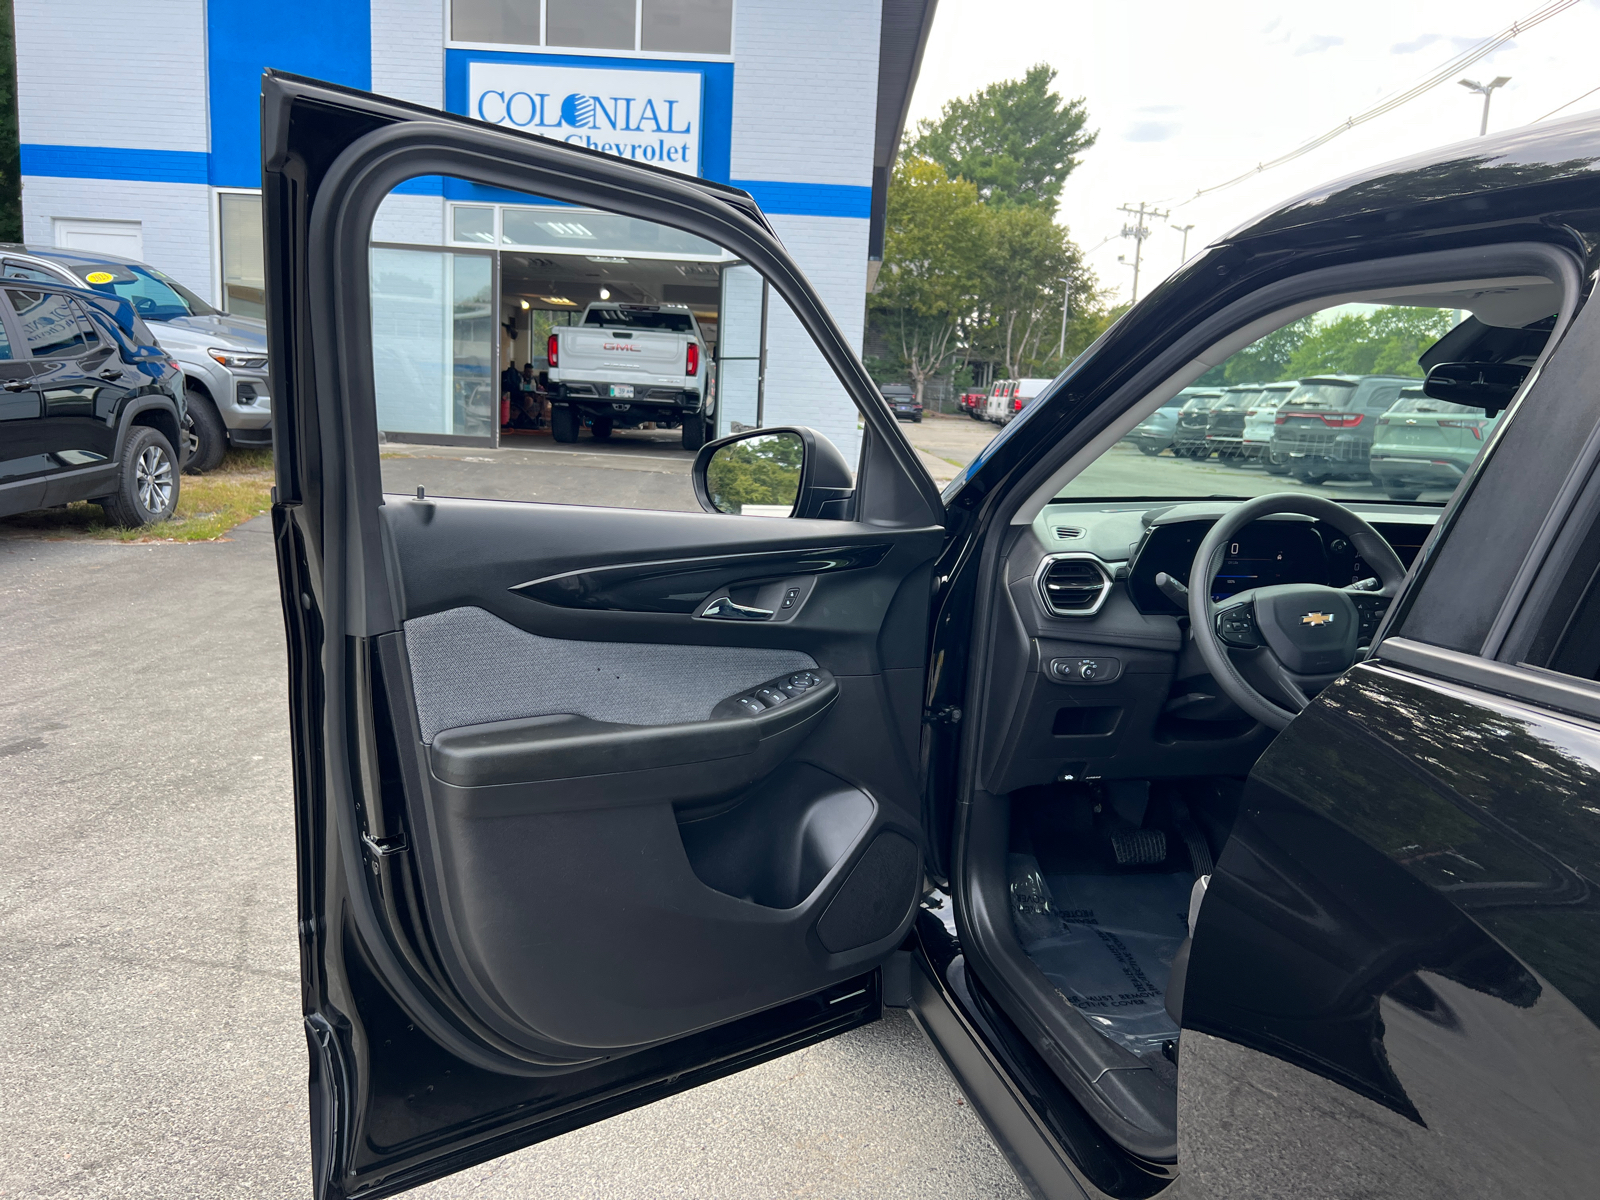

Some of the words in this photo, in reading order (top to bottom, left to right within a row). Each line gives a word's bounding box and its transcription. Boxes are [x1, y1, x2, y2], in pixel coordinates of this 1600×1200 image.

[478, 90, 691, 134] COLONIAL
[604, 342, 641, 352] GMC
[1230, 543, 1239, 555] 0
[1111, 999, 1146, 1007] COVER
